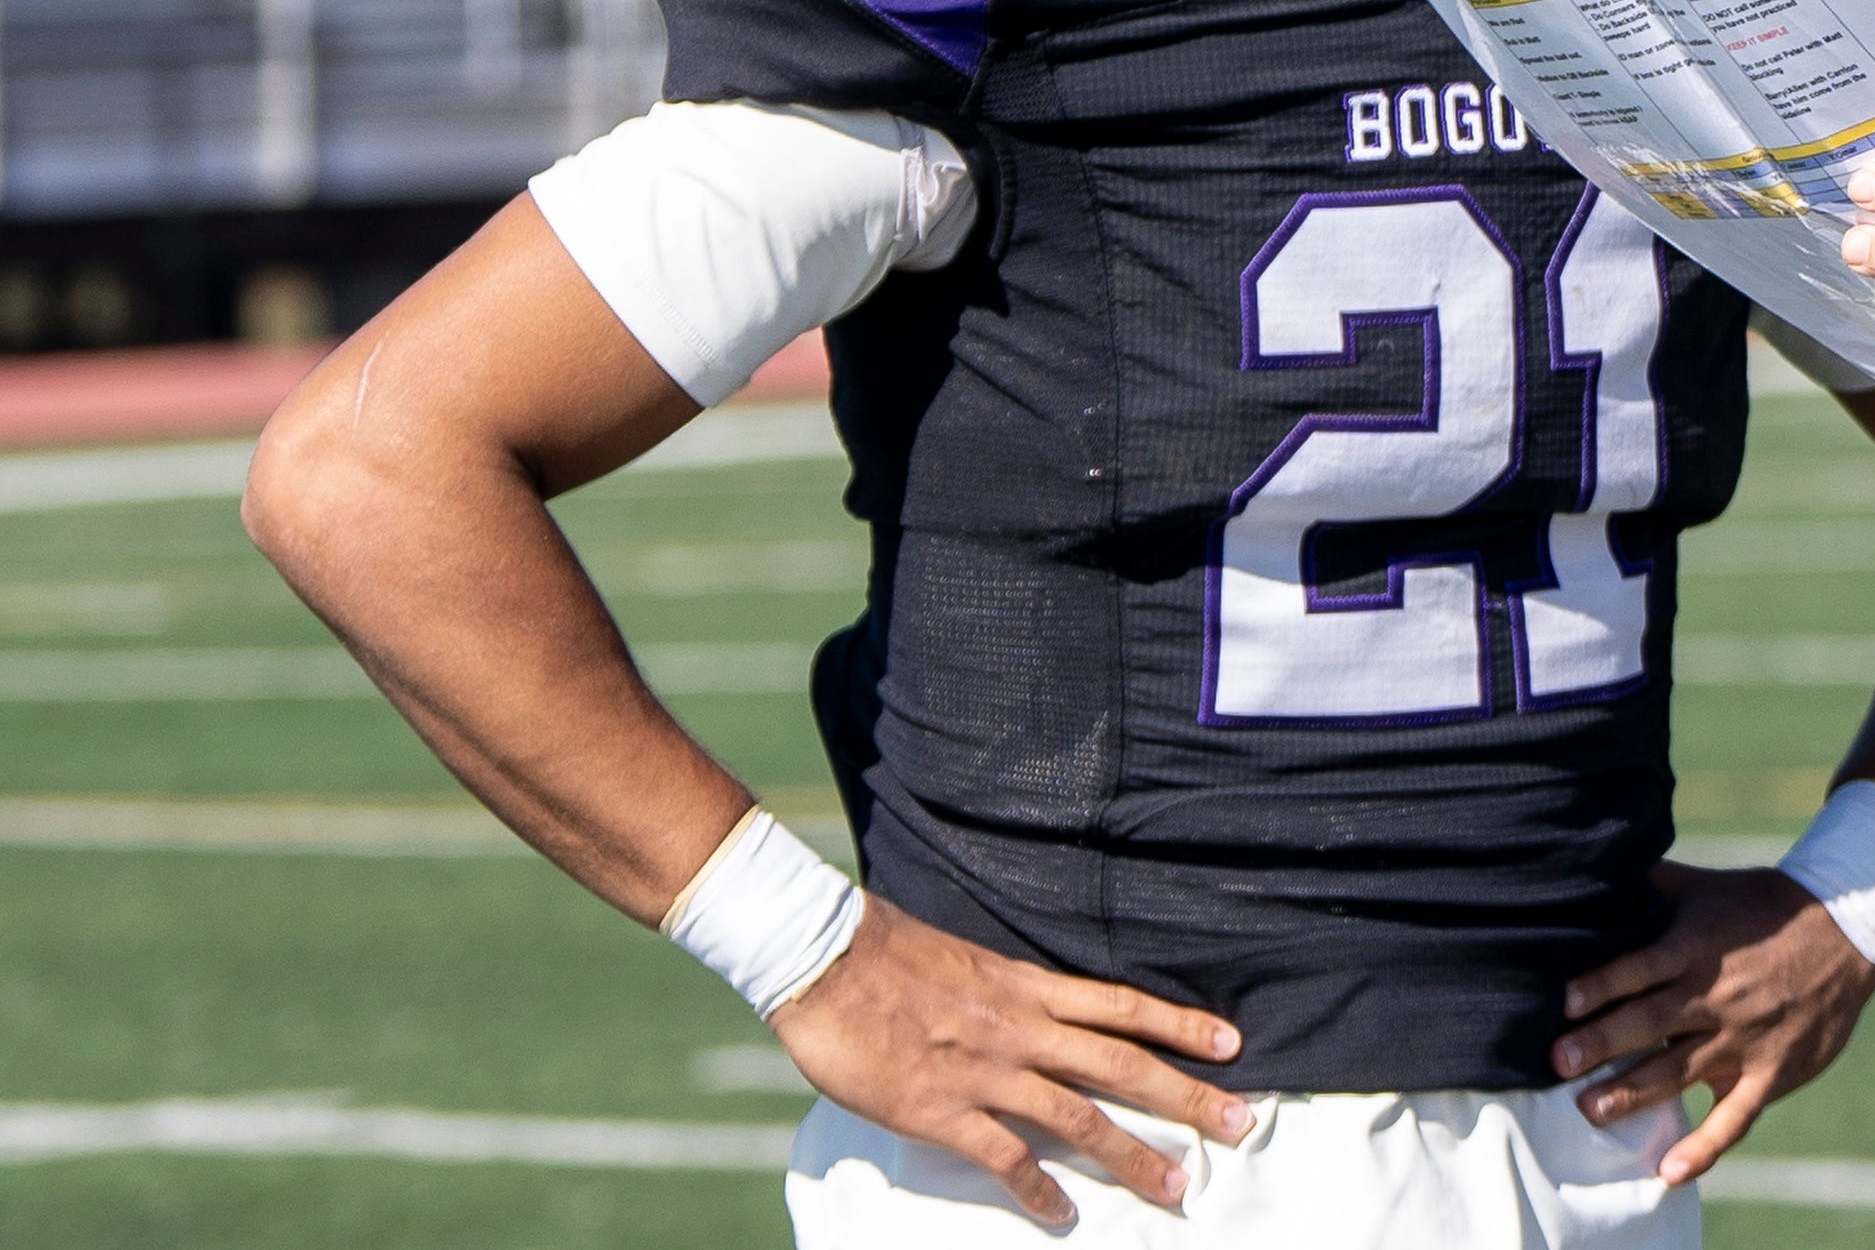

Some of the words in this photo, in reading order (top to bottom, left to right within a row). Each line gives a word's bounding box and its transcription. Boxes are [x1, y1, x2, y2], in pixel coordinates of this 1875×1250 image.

[1600, 0, 1611, 7] do
[1603, 3, 1635, 18] Corners
[1715, 8, 1733, 18] NOT
[1734, 3, 1749, 13] call
[1610, 11, 1647, 28] Backside
[1725, 18, 1745, 28] have
[1745, 12, 1760, 21] not
[1760, 0, 1798, 18] practiced
[1747, 36, 1757, 45] IT
[1757, 26, 1790, 42] SIMPLE
[1754, 59, 1768, 68] not
[1768, 54, 1783, 64] call
[1805, 40, 1824, 50] with
[1822, 31, 1844, 43] Matt
[1791, 95, 1809, 105] him
[1809, 87, 1832, 99] come
[1831, 78, 1853, 90] from
[1851, 73, 1867, 82] the
[1809, 75, 1827, 86] with
[1343, 81, 1552, 163] BOGO
[1200, 178, 1672, 727] 21
